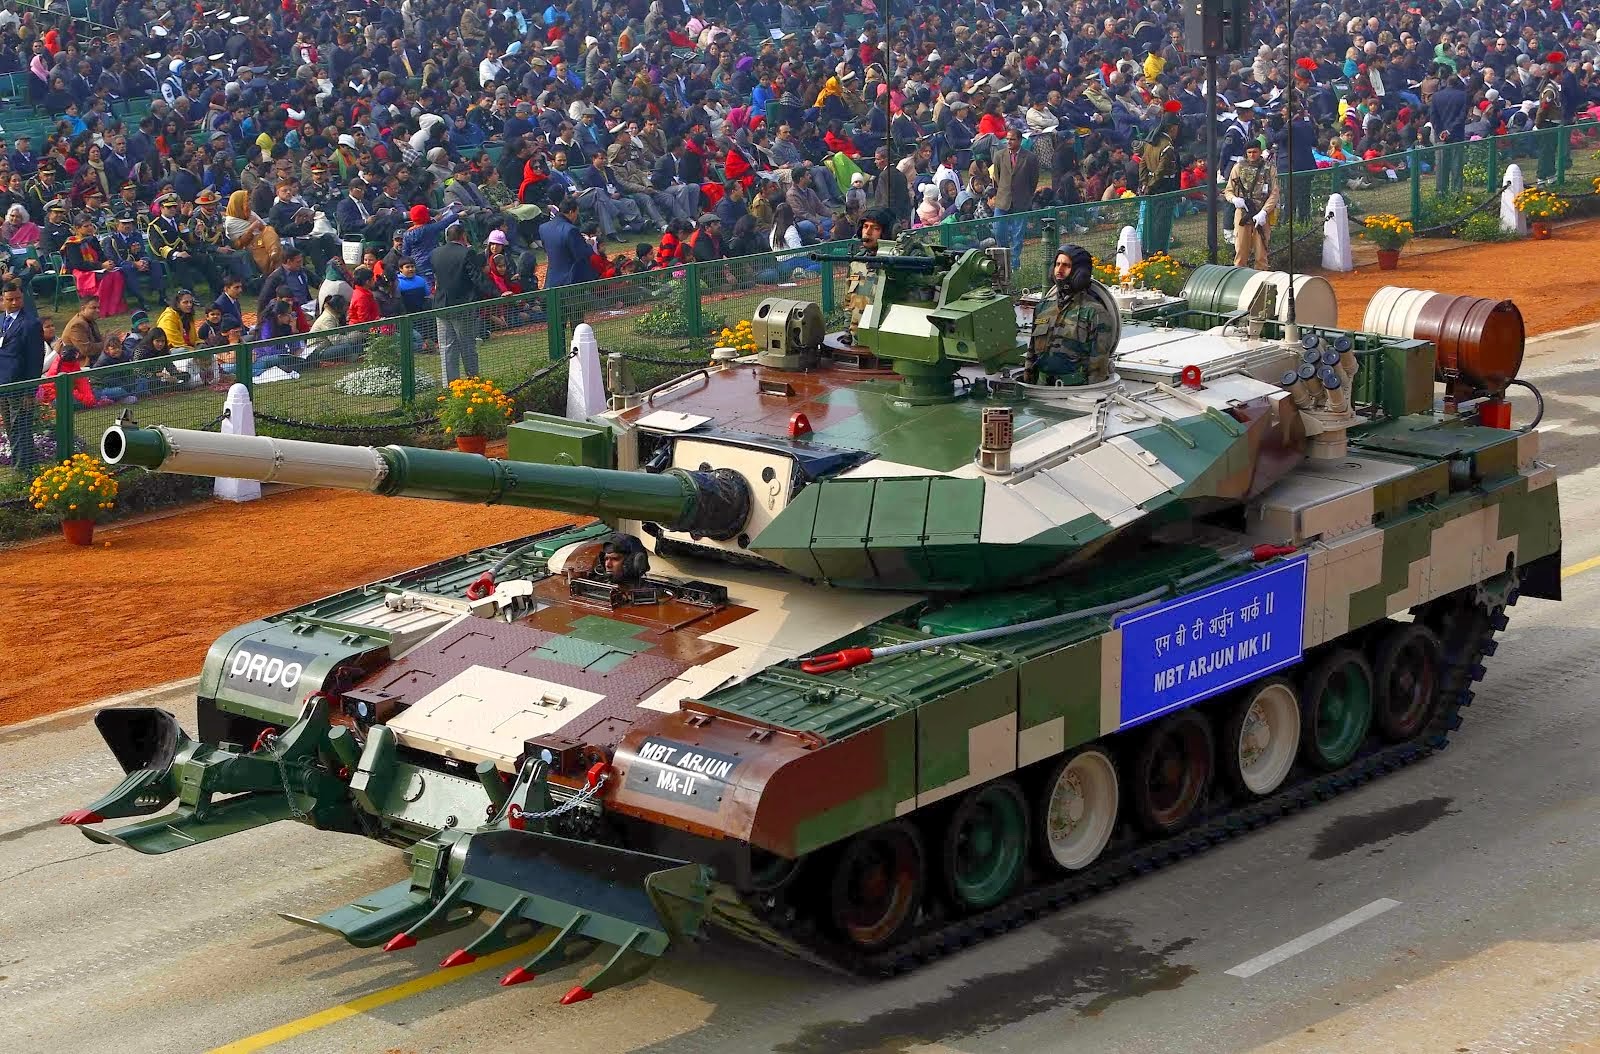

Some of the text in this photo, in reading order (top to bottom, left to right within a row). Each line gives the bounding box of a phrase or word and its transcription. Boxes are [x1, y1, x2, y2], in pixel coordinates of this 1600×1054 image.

[1155, 634, 1171, 657] एम
[1175, 623, 1187, 647] बी
[1191, 617, 1204, 640] टी
[1208, 607, 1235, 638] अर्जुन
[1240, 596, 1261, 623] मार्क
[230, 649, 303, 688] DRDO
[1154, 631, 1271, 693] MBT ARJUN MK II
[638, 741, 733, 779] MBT ARJUN
